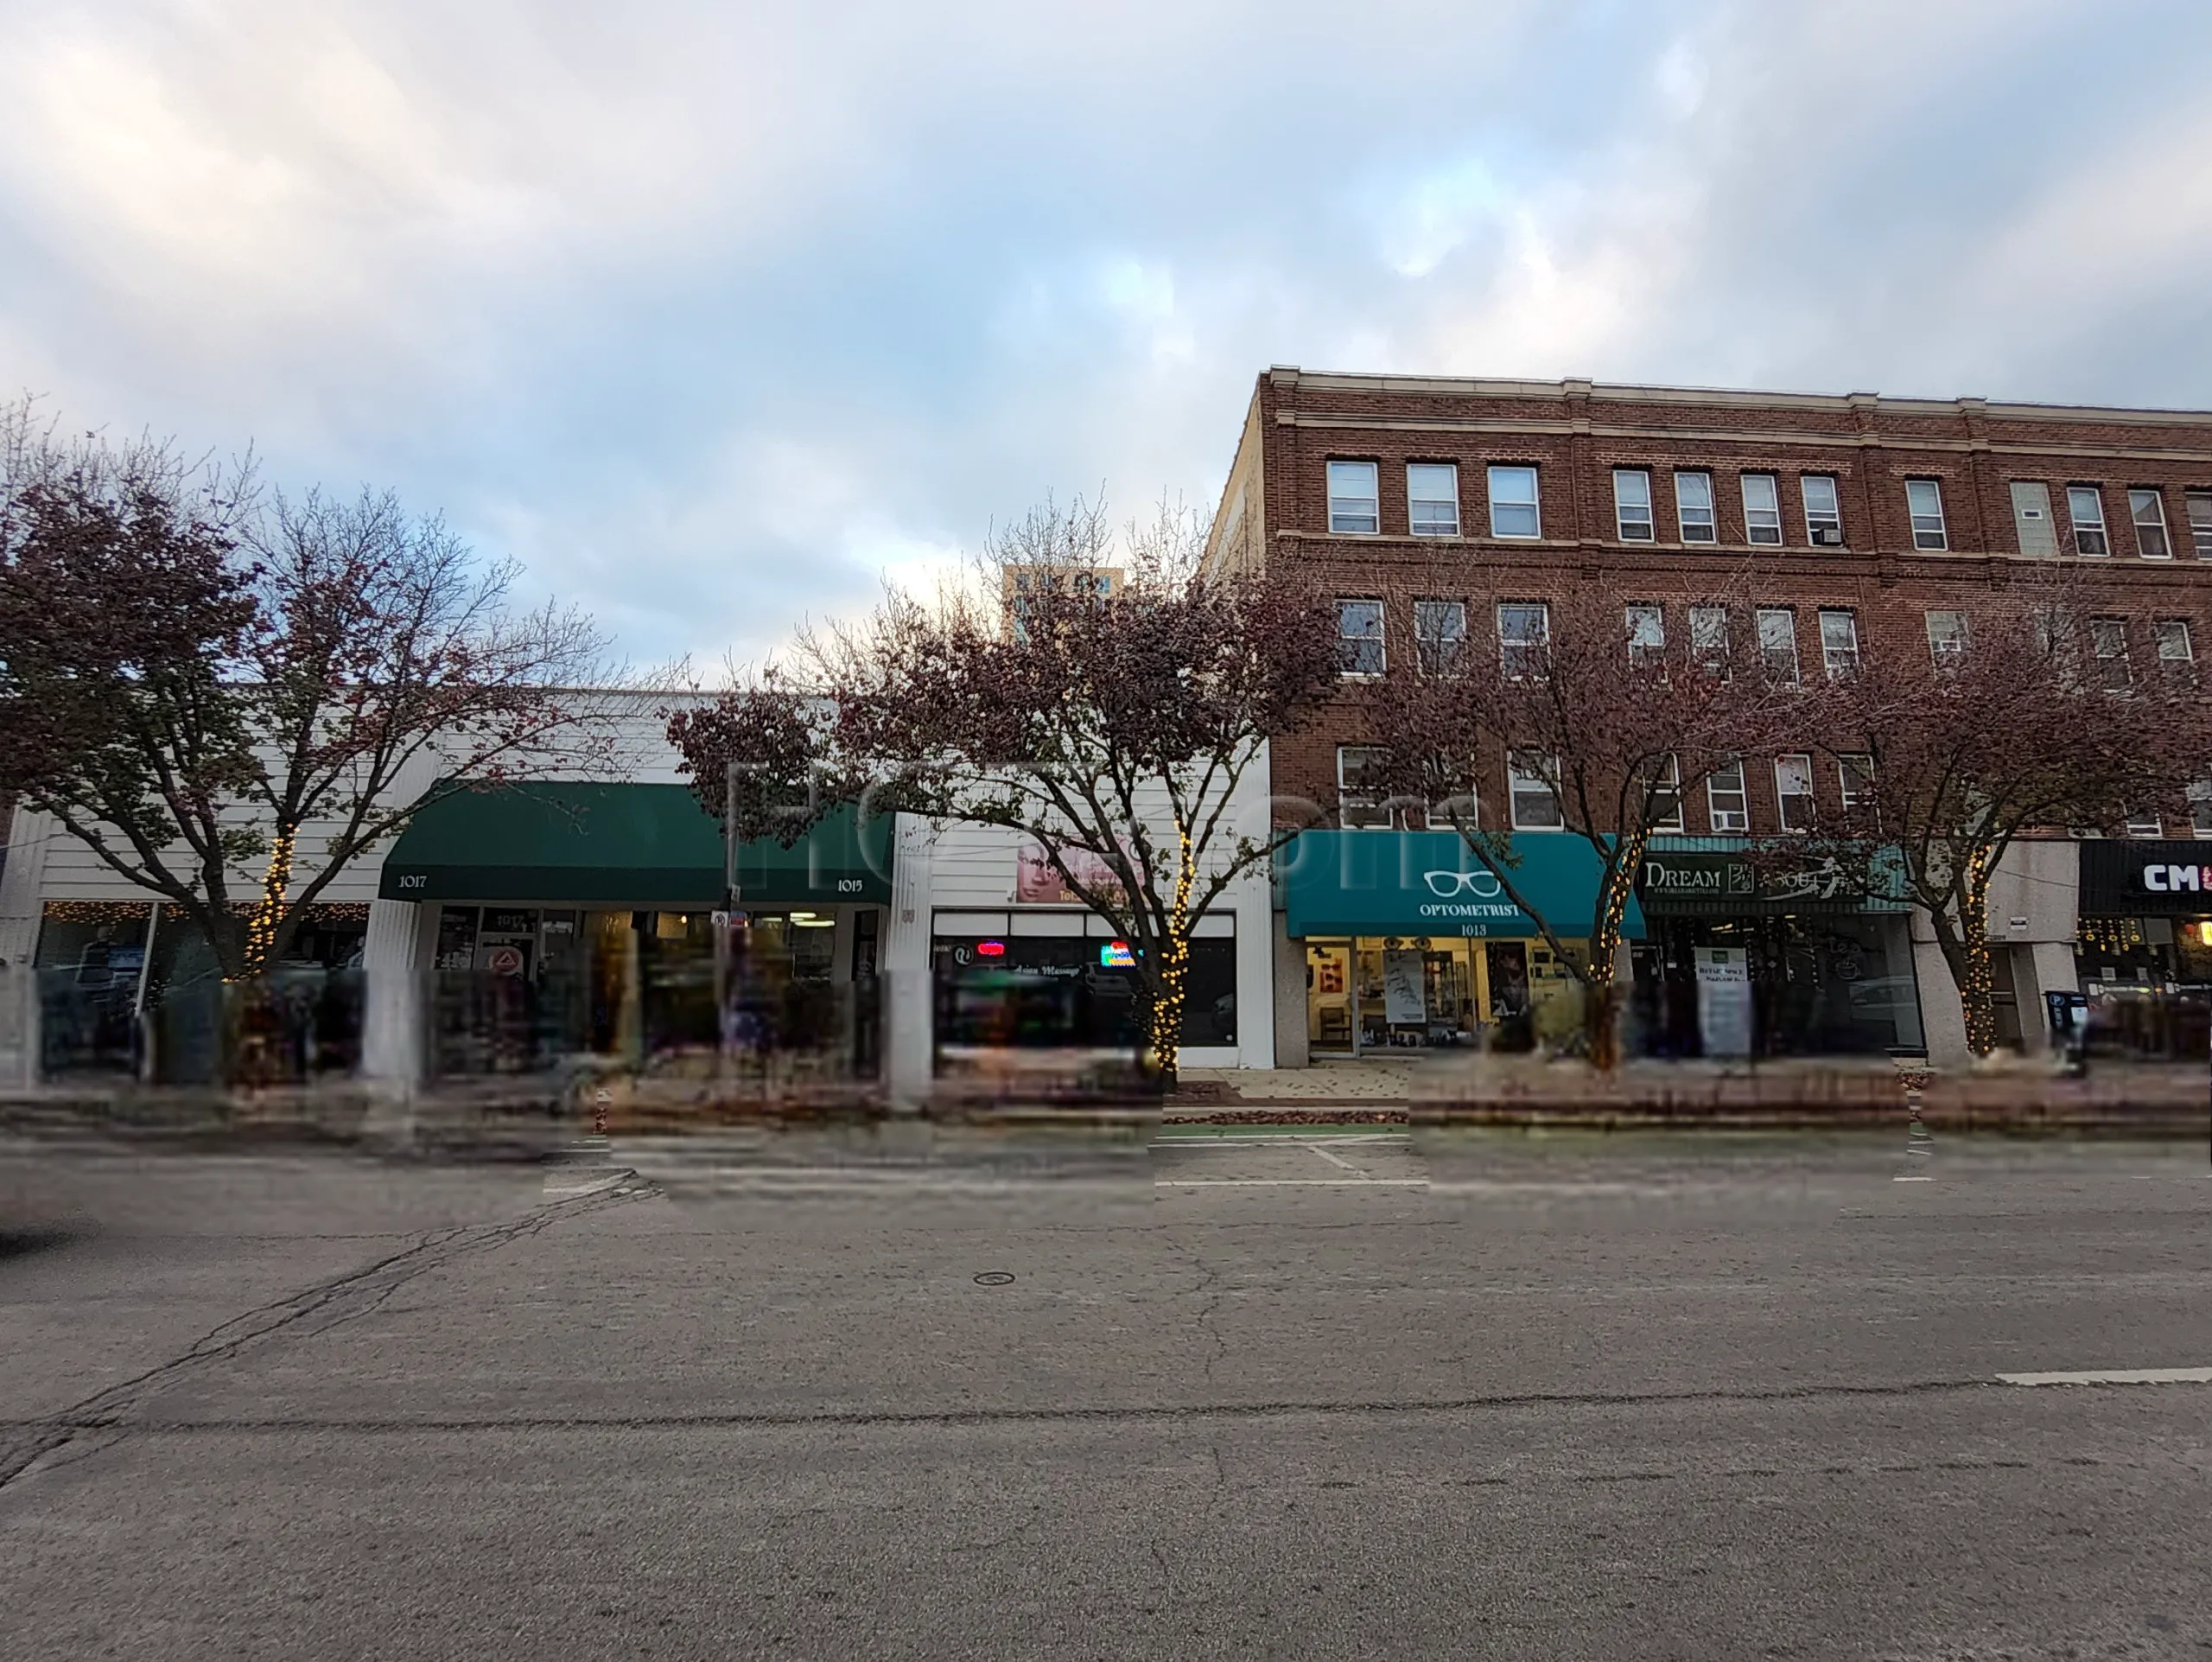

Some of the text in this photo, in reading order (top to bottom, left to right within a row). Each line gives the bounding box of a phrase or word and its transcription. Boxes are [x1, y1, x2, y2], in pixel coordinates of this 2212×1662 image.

[1645, 862, 1721, 887] DREAM
[398, 876, 428, 888] 1017
[837, 880, 863, 892] 1015
[1420, 904, 1520, 917] OPTOMETRIST
[1461, 924, 1487, 937] 1013
